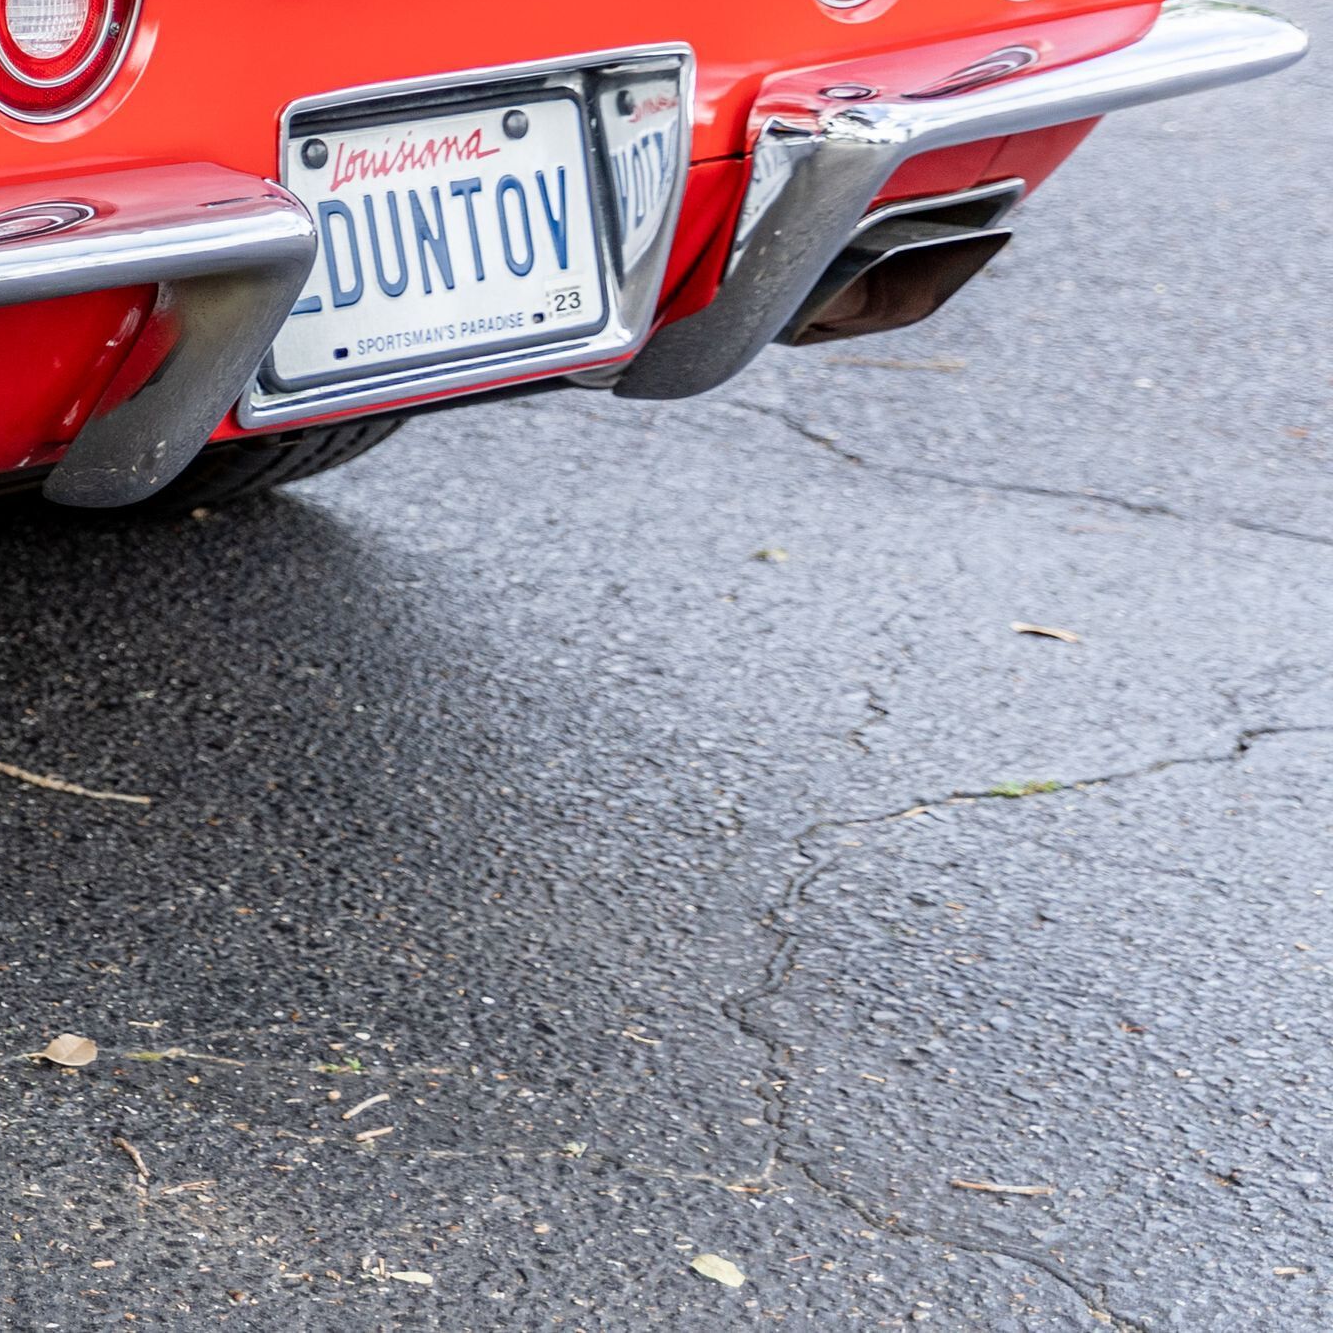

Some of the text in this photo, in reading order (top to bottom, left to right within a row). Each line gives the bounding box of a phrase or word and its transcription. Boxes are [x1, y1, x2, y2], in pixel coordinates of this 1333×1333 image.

[330, 128, 501, 192] Louisiana
[290, 165, 569, 316] DUNTOV
[553, 291, 582, 312] 23
[356, 312, 525, 356] SPORTSMAN'S PARADISE
